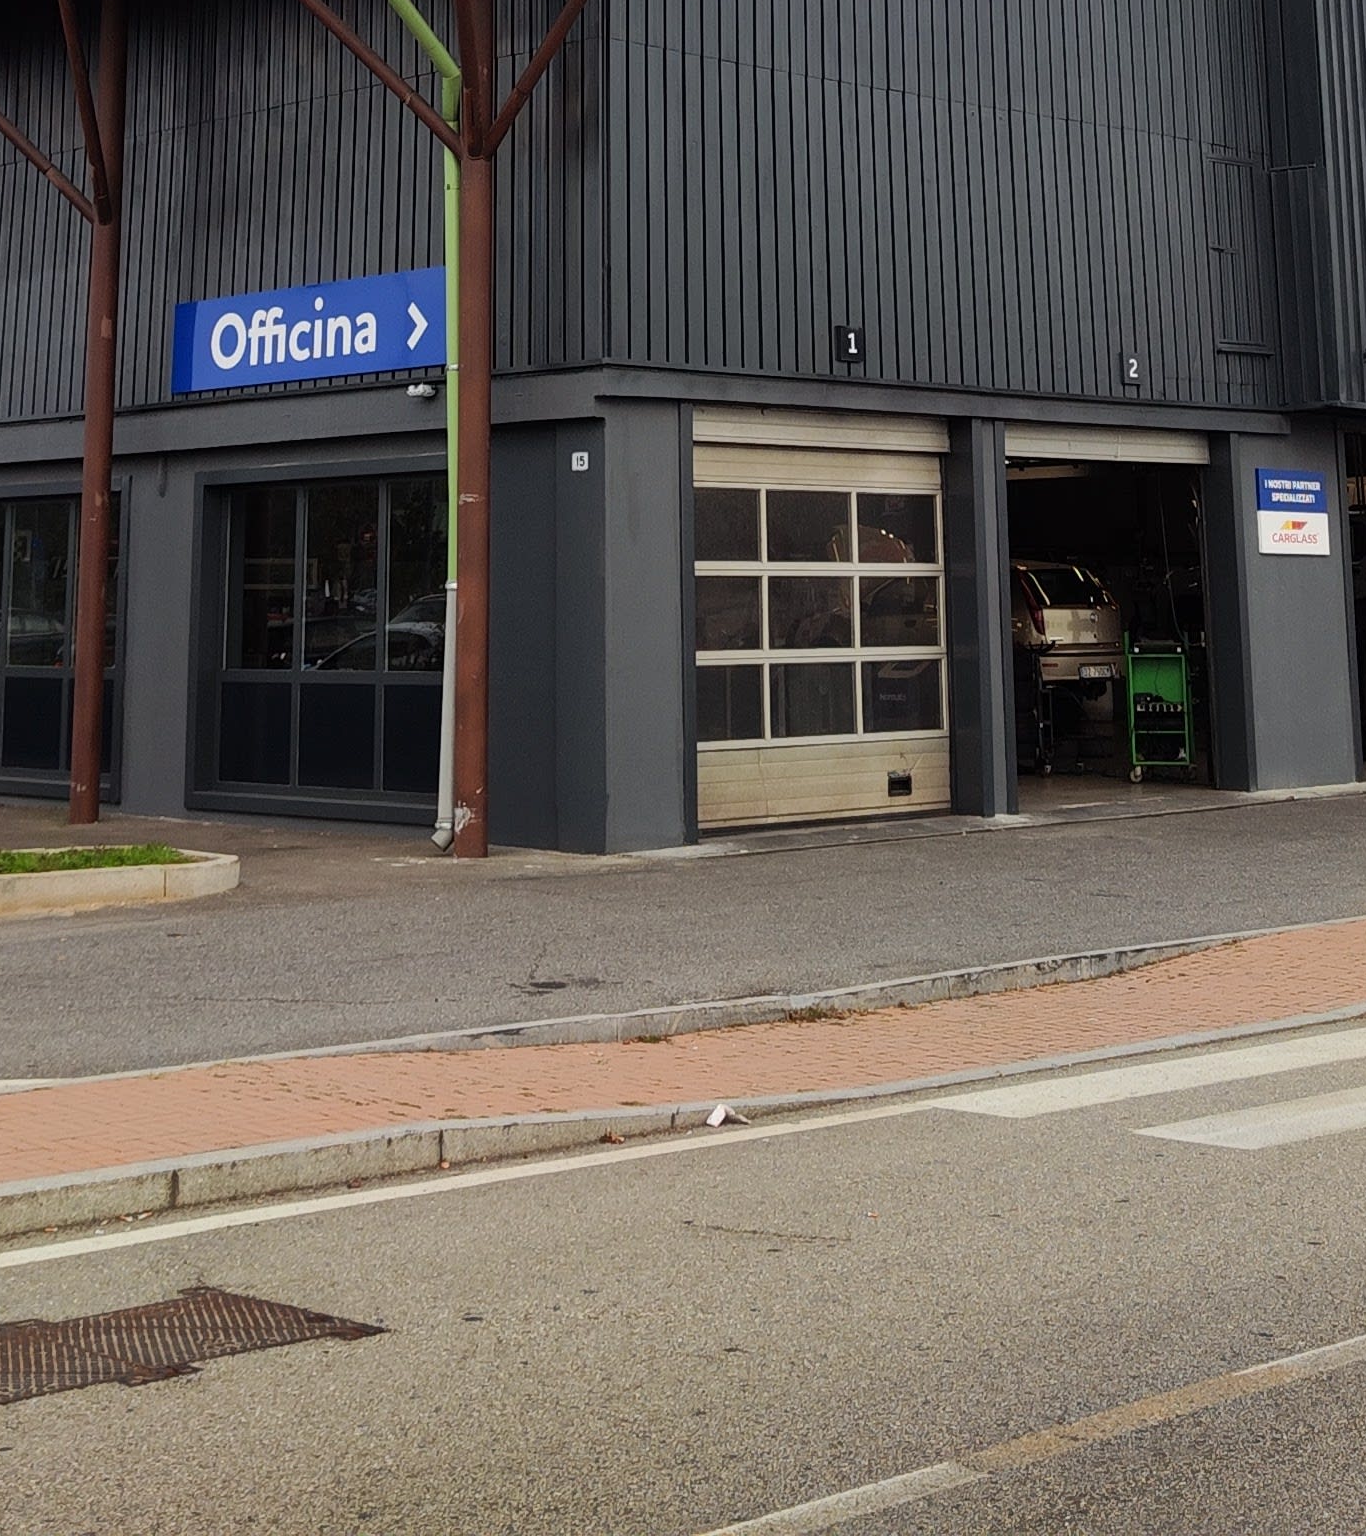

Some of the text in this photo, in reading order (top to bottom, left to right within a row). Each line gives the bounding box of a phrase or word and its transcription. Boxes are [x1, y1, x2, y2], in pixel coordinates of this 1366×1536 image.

[210, 296, 378, 370] Officina
[847, 332, 858, 354] 1
[1128, 358, 1139, 378] 2
[576, 455, 585, 467] 15
[1272, 532, 1319, 544] CARGLASS
